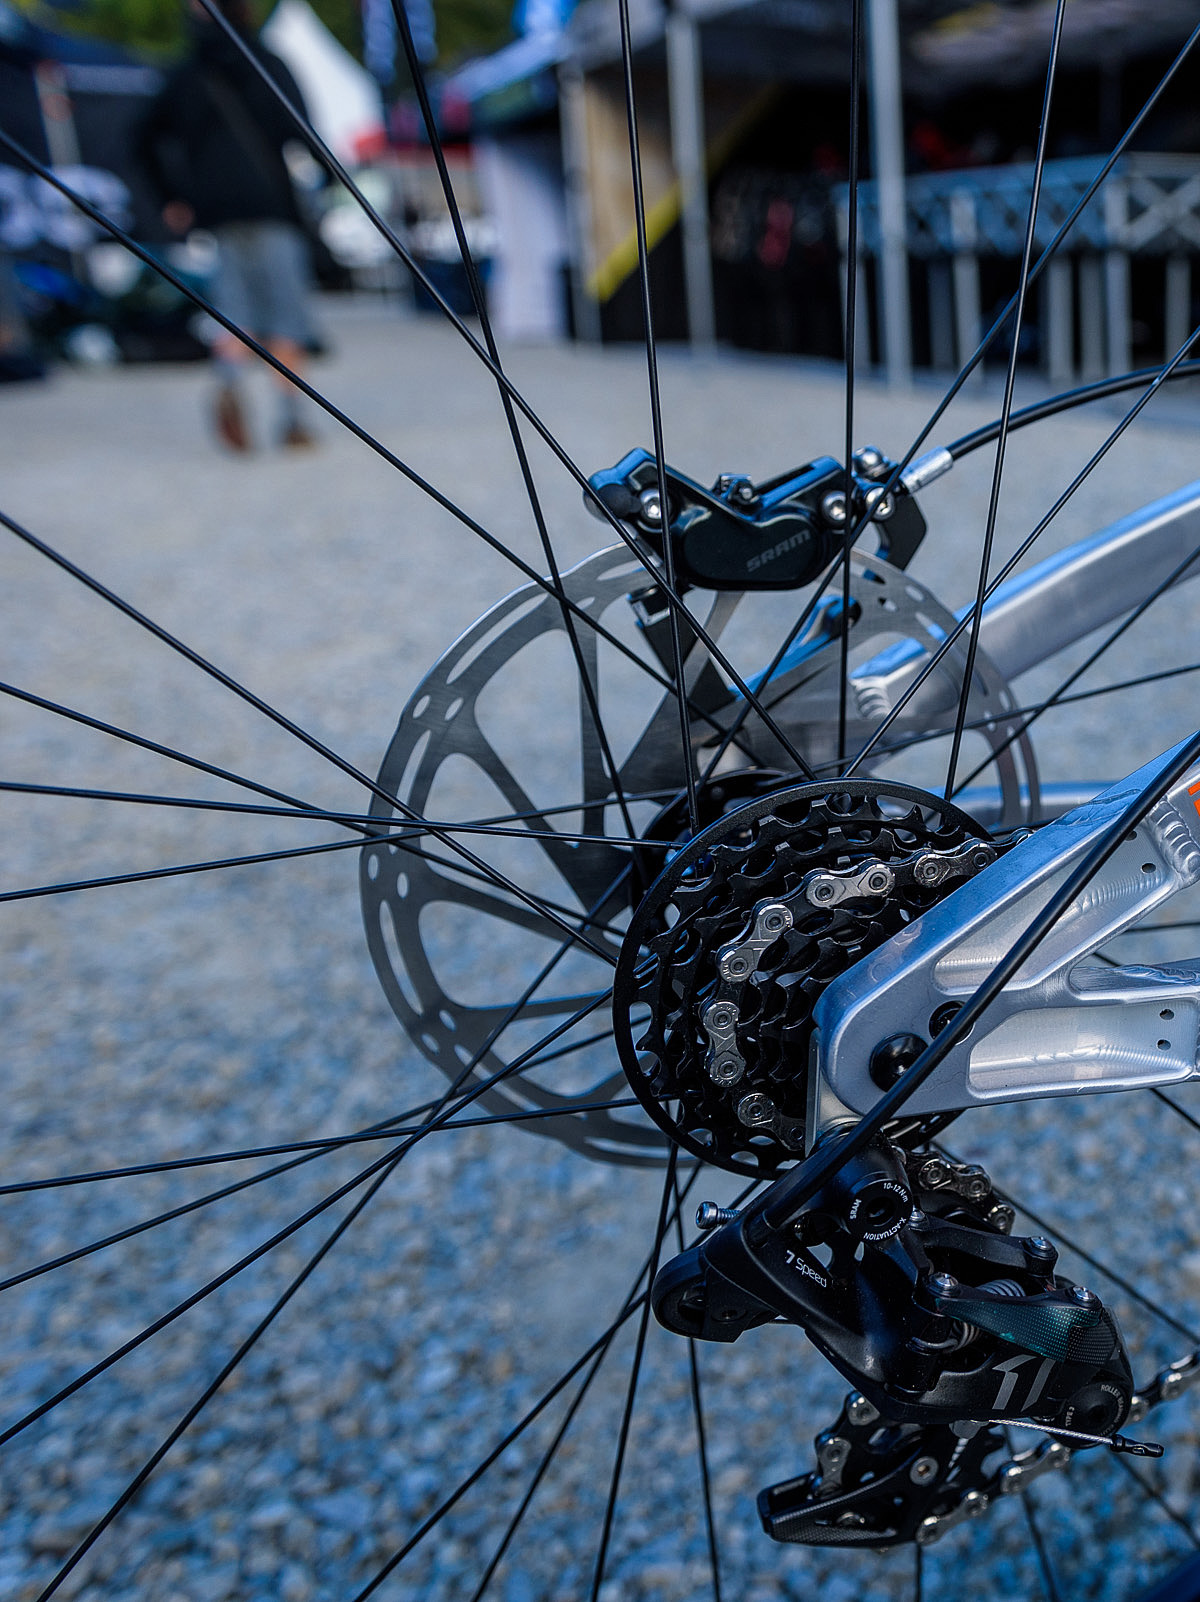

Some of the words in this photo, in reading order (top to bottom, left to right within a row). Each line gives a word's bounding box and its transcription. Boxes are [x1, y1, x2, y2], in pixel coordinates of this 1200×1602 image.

[746, 529, 811, 573] SRAM
[849, 1198, 862, 1220] SRAM
[863, 1216, 907, 1241] X-ACTUATION
